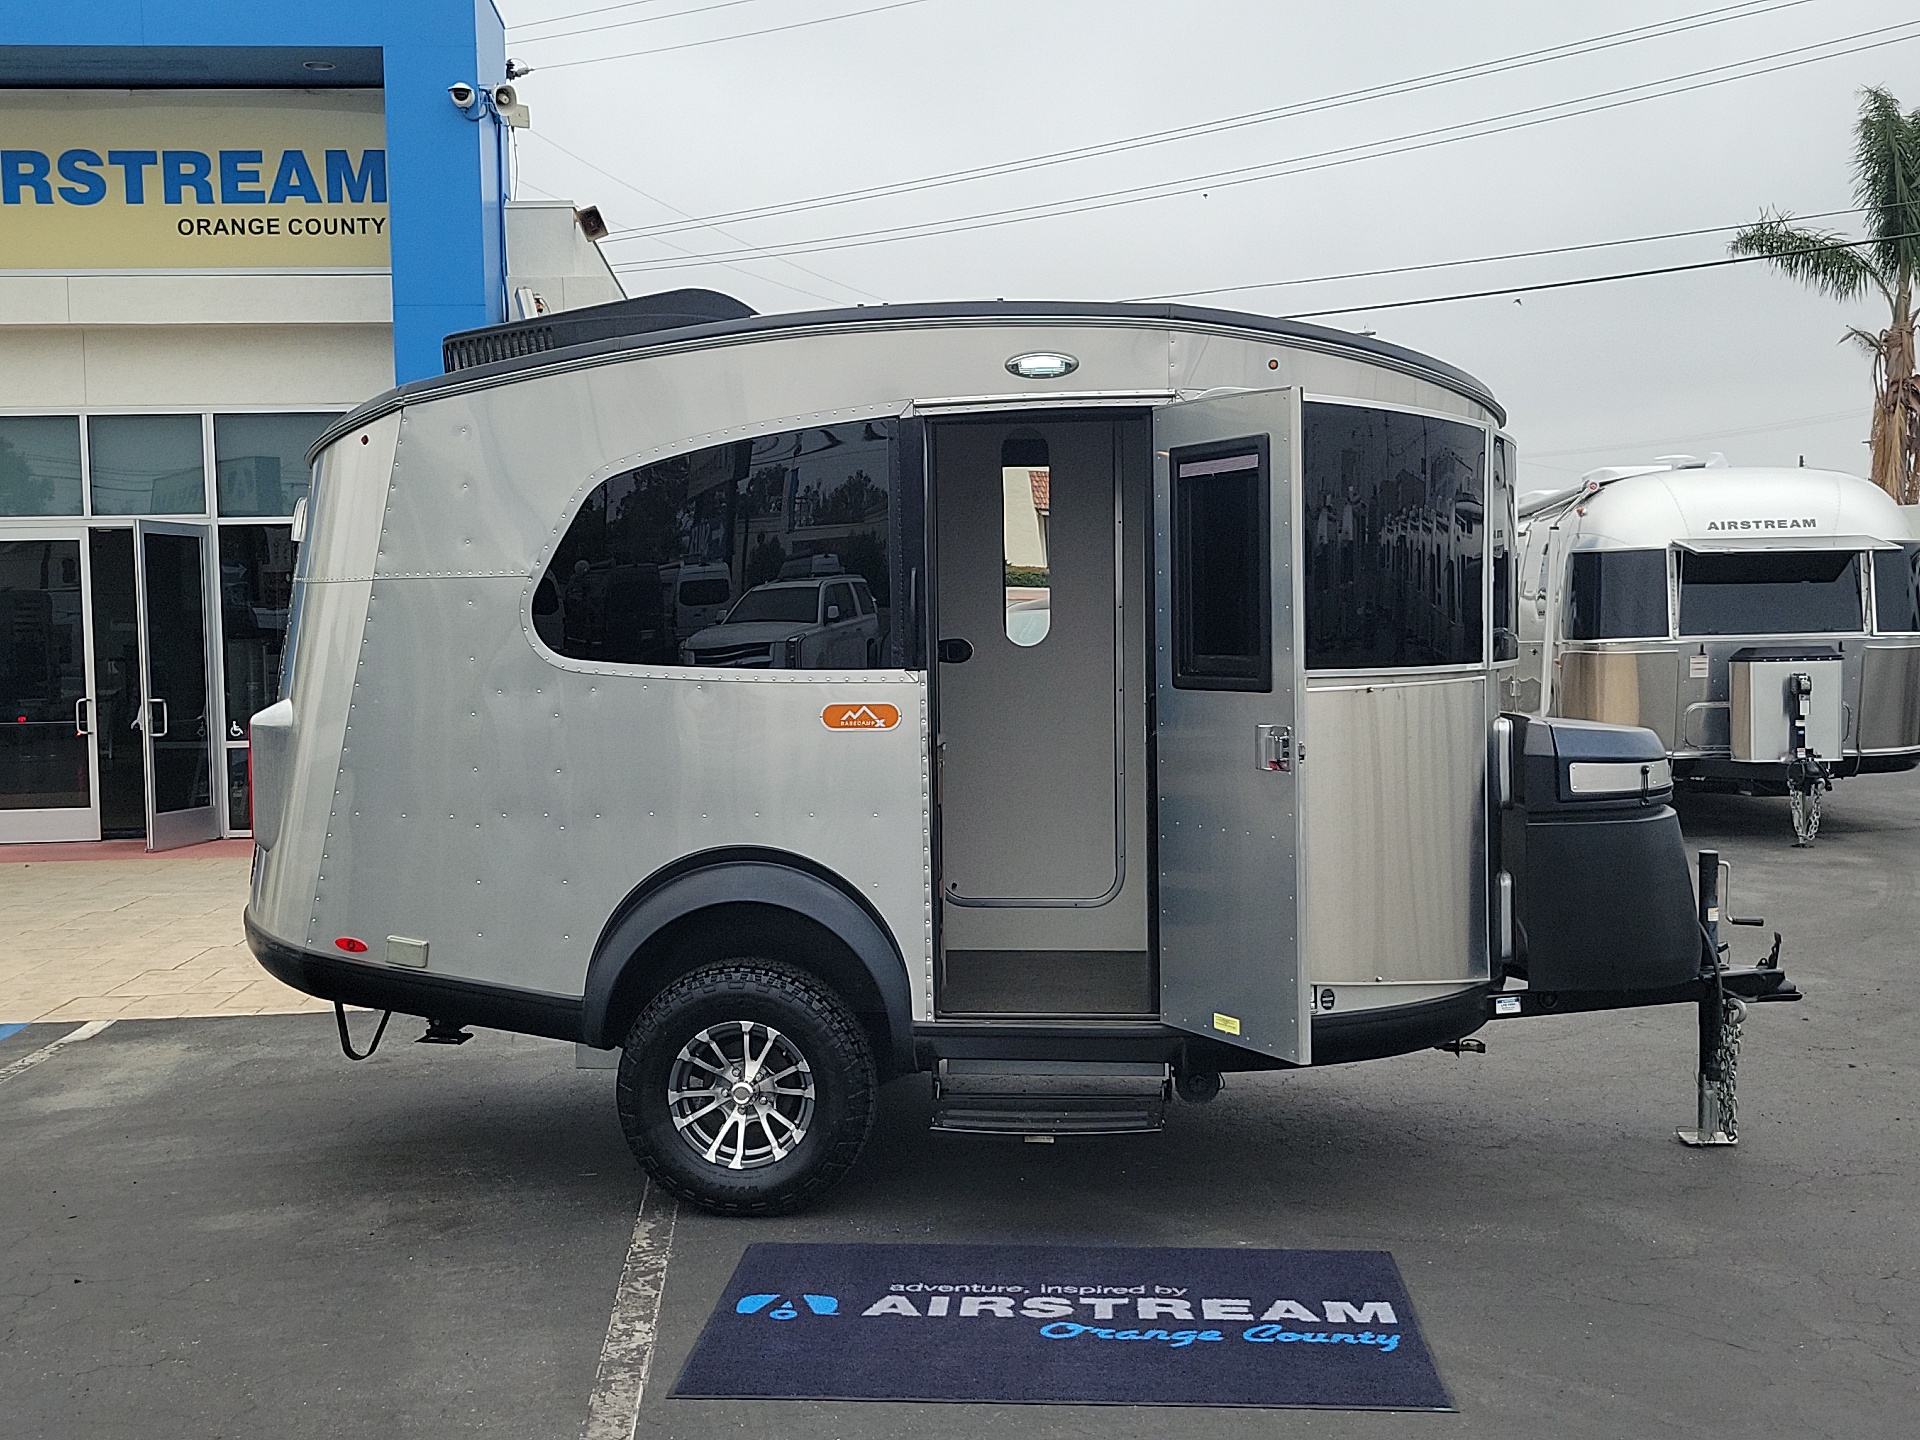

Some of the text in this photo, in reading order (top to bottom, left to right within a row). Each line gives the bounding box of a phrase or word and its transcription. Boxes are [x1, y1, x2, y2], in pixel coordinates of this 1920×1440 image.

[0, 149, 388, 206] RSTREAM
[177, 217, 387, 236] ORANGE COUNTY
[1706, 518, 1817, 531] AIRSTREAM
[1040, 1283, 1146, 1296] inspired
[1153, 1284, 1188, 1297] by
[860, 1295, 1399, 1325] AIRSTREAM
[1039, 1321, 1402, 1352] Orange County
